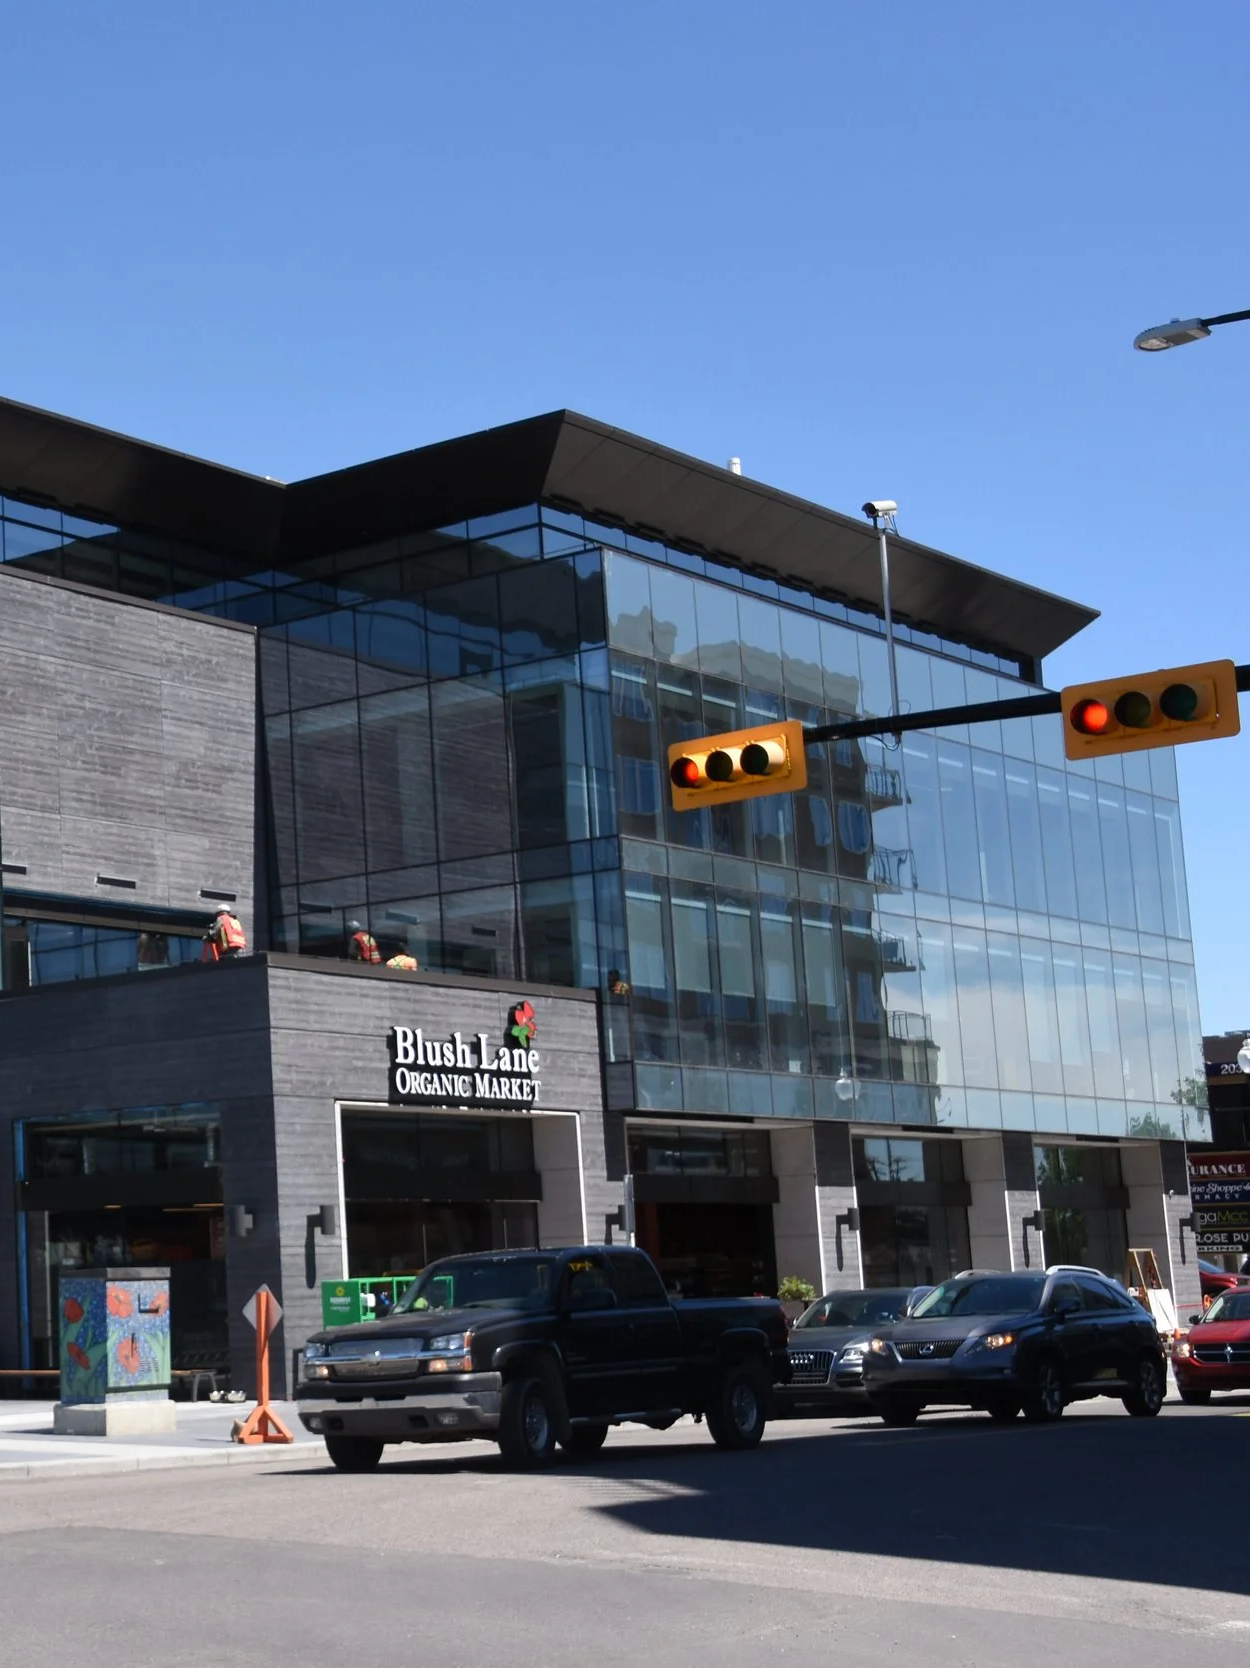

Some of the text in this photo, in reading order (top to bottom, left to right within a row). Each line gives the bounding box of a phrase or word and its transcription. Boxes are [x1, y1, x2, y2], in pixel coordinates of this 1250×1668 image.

[393, 1026, 540, 1073] Blush Lane
[395, 1067, 542, 1101] ORGANIC MARKET
[1188, 1163, 1246, 1176] URANCE
